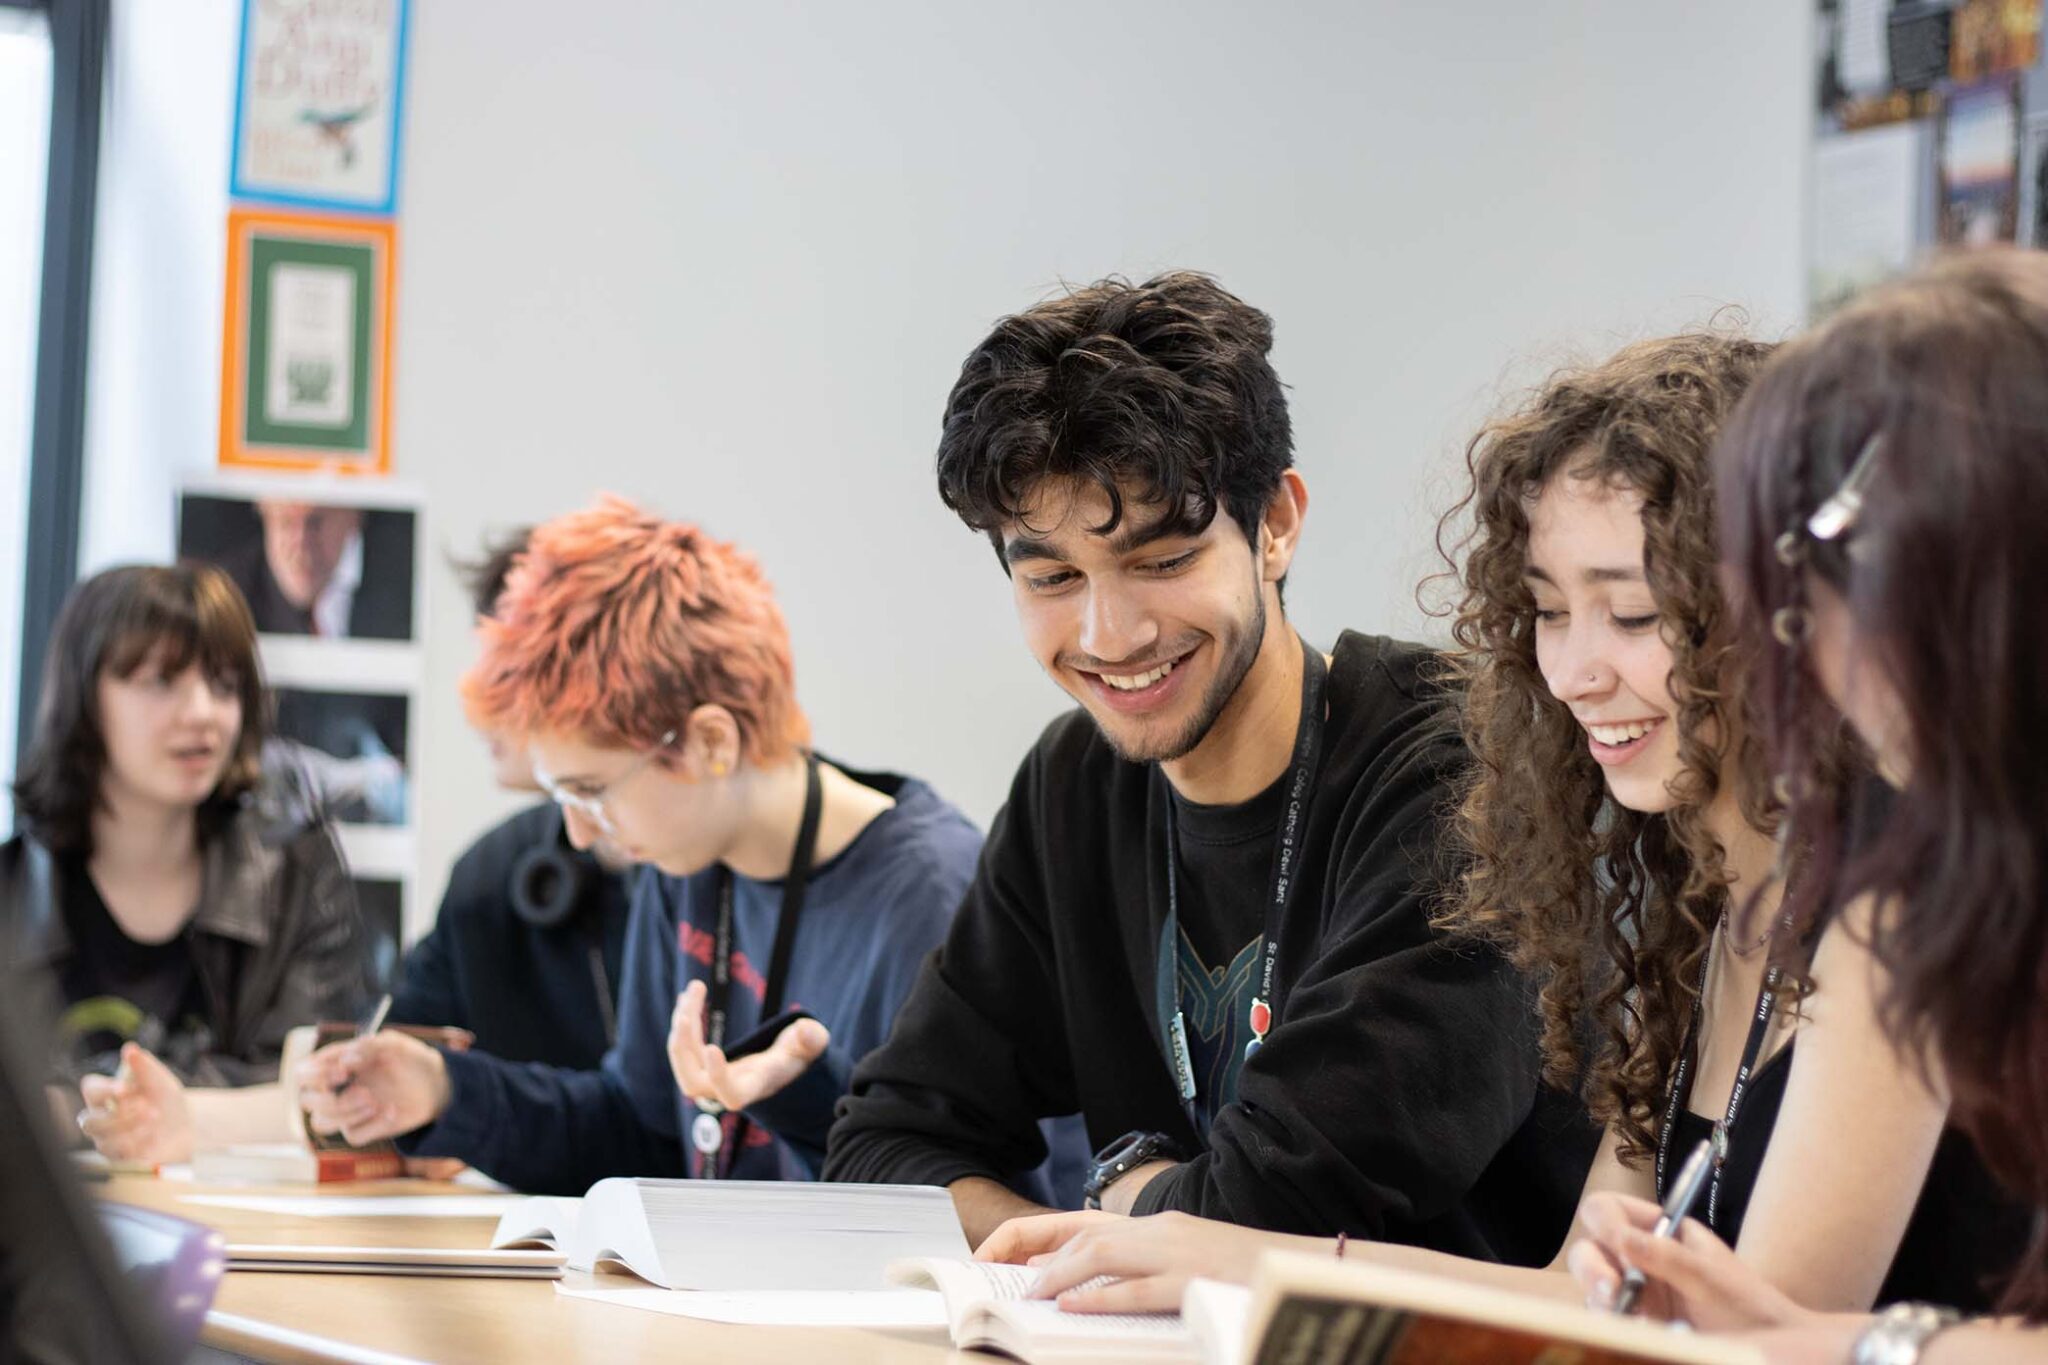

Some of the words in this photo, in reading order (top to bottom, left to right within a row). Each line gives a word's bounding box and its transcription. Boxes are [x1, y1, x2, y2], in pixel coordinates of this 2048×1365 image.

[1281, 848, 1292, 876] Dewi
[1267, 941, 1277, 955] St
[1262, 957, 1275, 996] David's
[1758, 991, 1771, 1020] Sant
[1740, 1066, 1749, 1080] St
